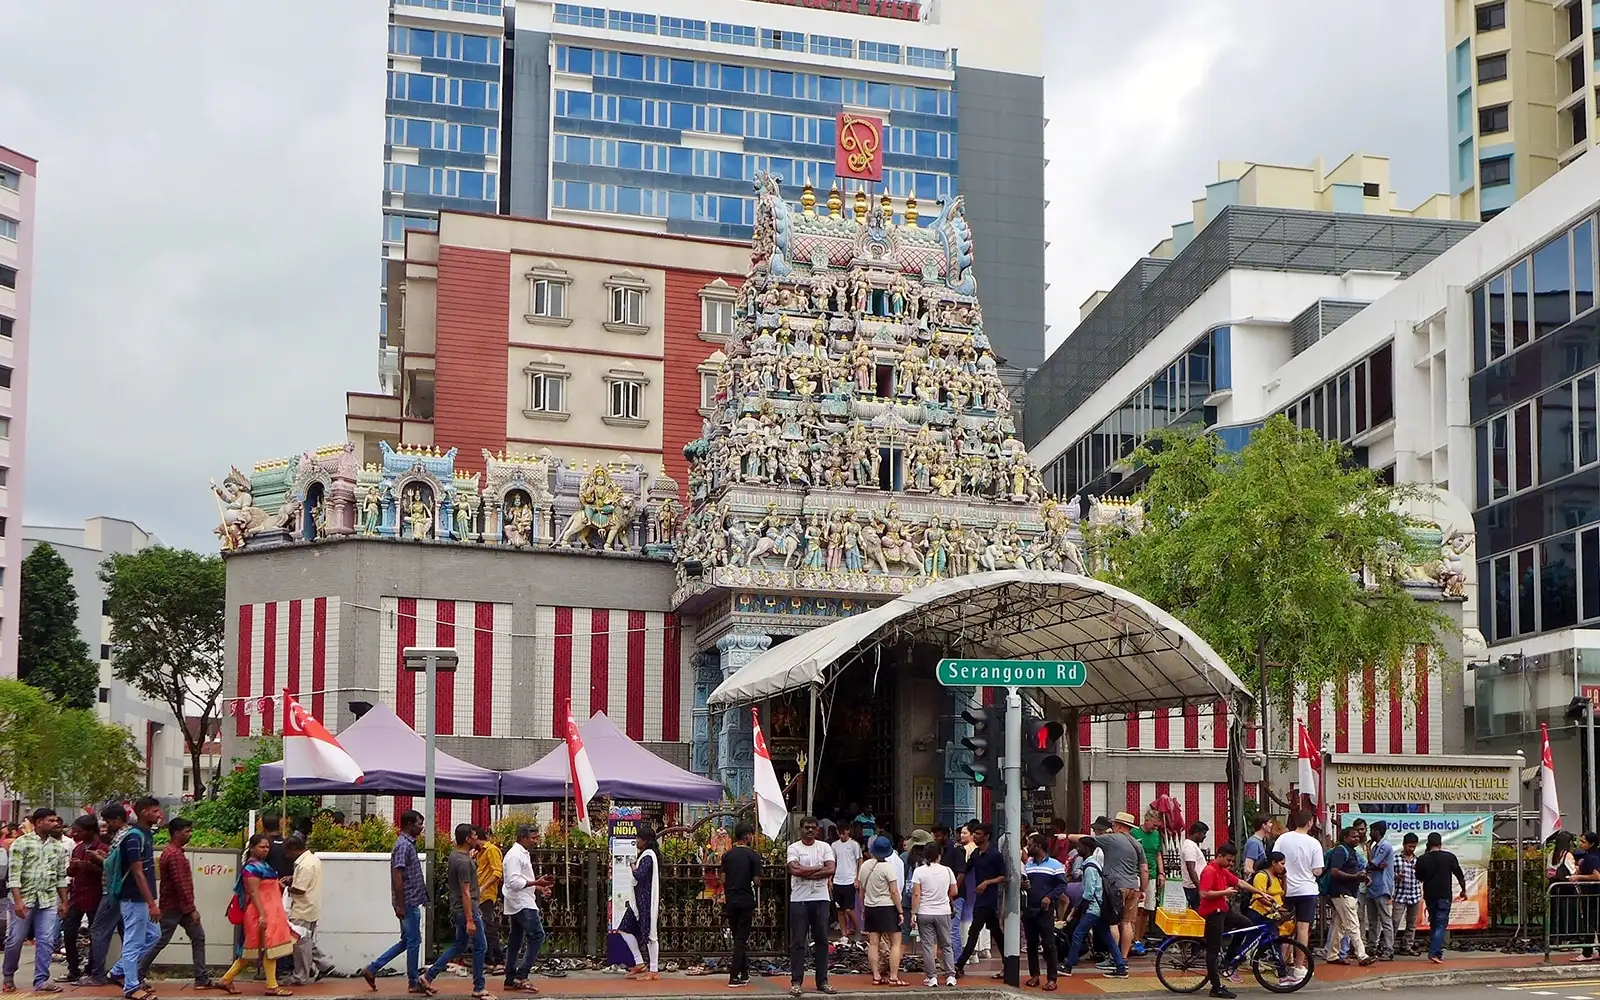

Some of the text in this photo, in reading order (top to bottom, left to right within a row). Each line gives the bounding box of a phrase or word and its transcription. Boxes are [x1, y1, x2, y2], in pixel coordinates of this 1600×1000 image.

[949, 662, 1077, 682] Serangoon Rd
[1337, 776, 1509, 788] SRI VEERAMAKALIAMMAN TEMPLE
[1337, 792, 1350, 800] 141
[1353, 791, 1405, 801] SERANGOON
[1408, 791, 1433, 801] ROAD,
[1435, 791, 1481, 801] SINGAPORE
[613, 827, 637, 835] INDIA
[1384, 820, 1460, 832] roject Bhakti
